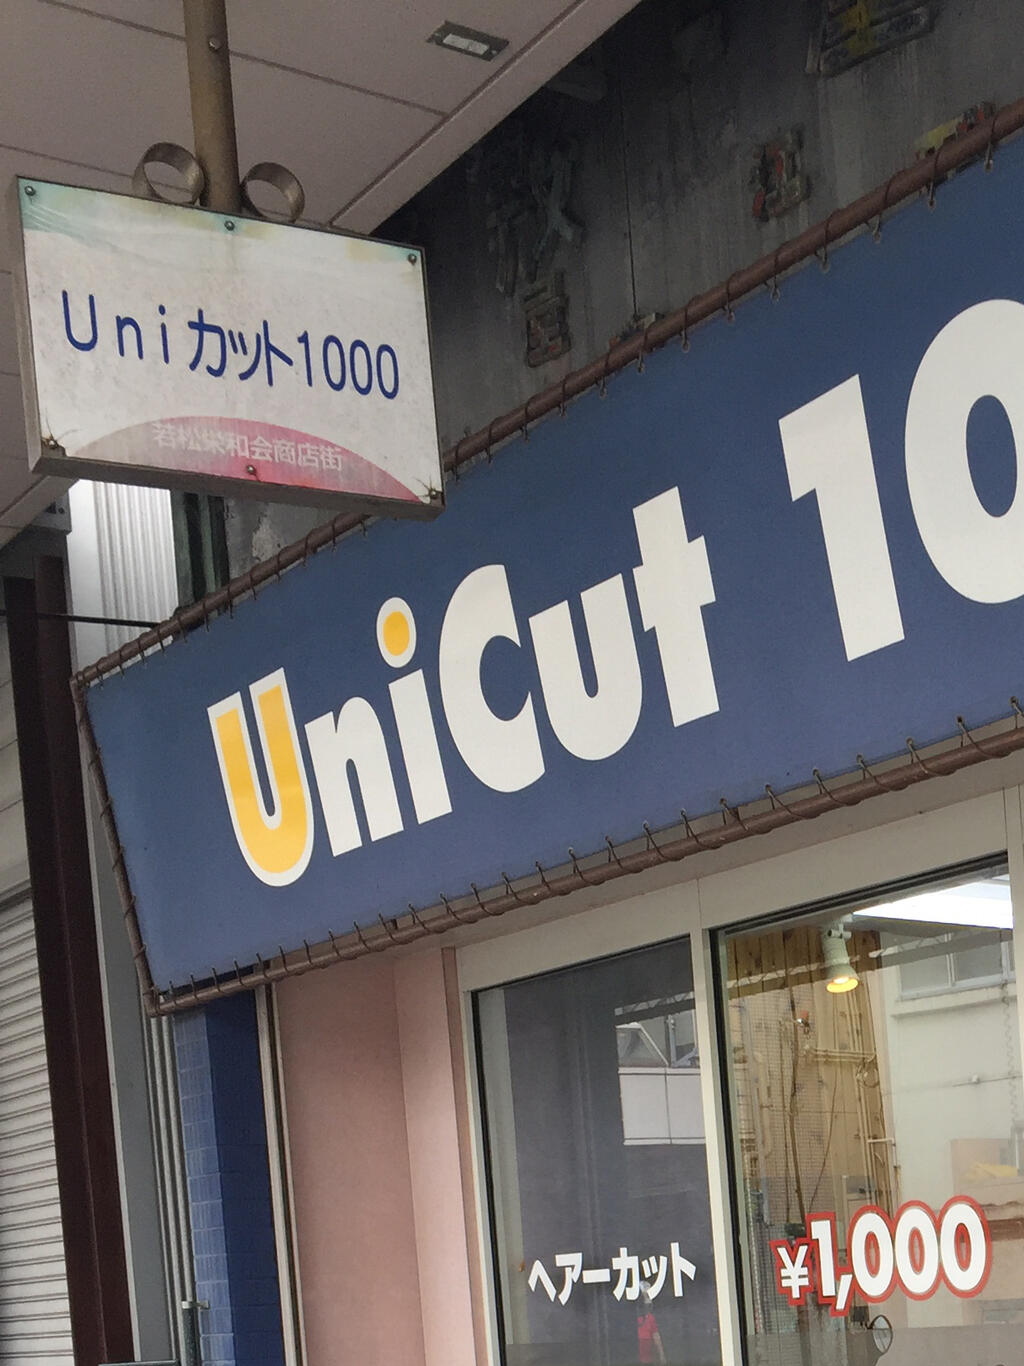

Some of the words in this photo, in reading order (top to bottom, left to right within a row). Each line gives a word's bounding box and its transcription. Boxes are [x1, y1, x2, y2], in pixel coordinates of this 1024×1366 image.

[207, 485, 720, 887] UniCut
[528, 1241, 697, 1305] ヘアーカット
